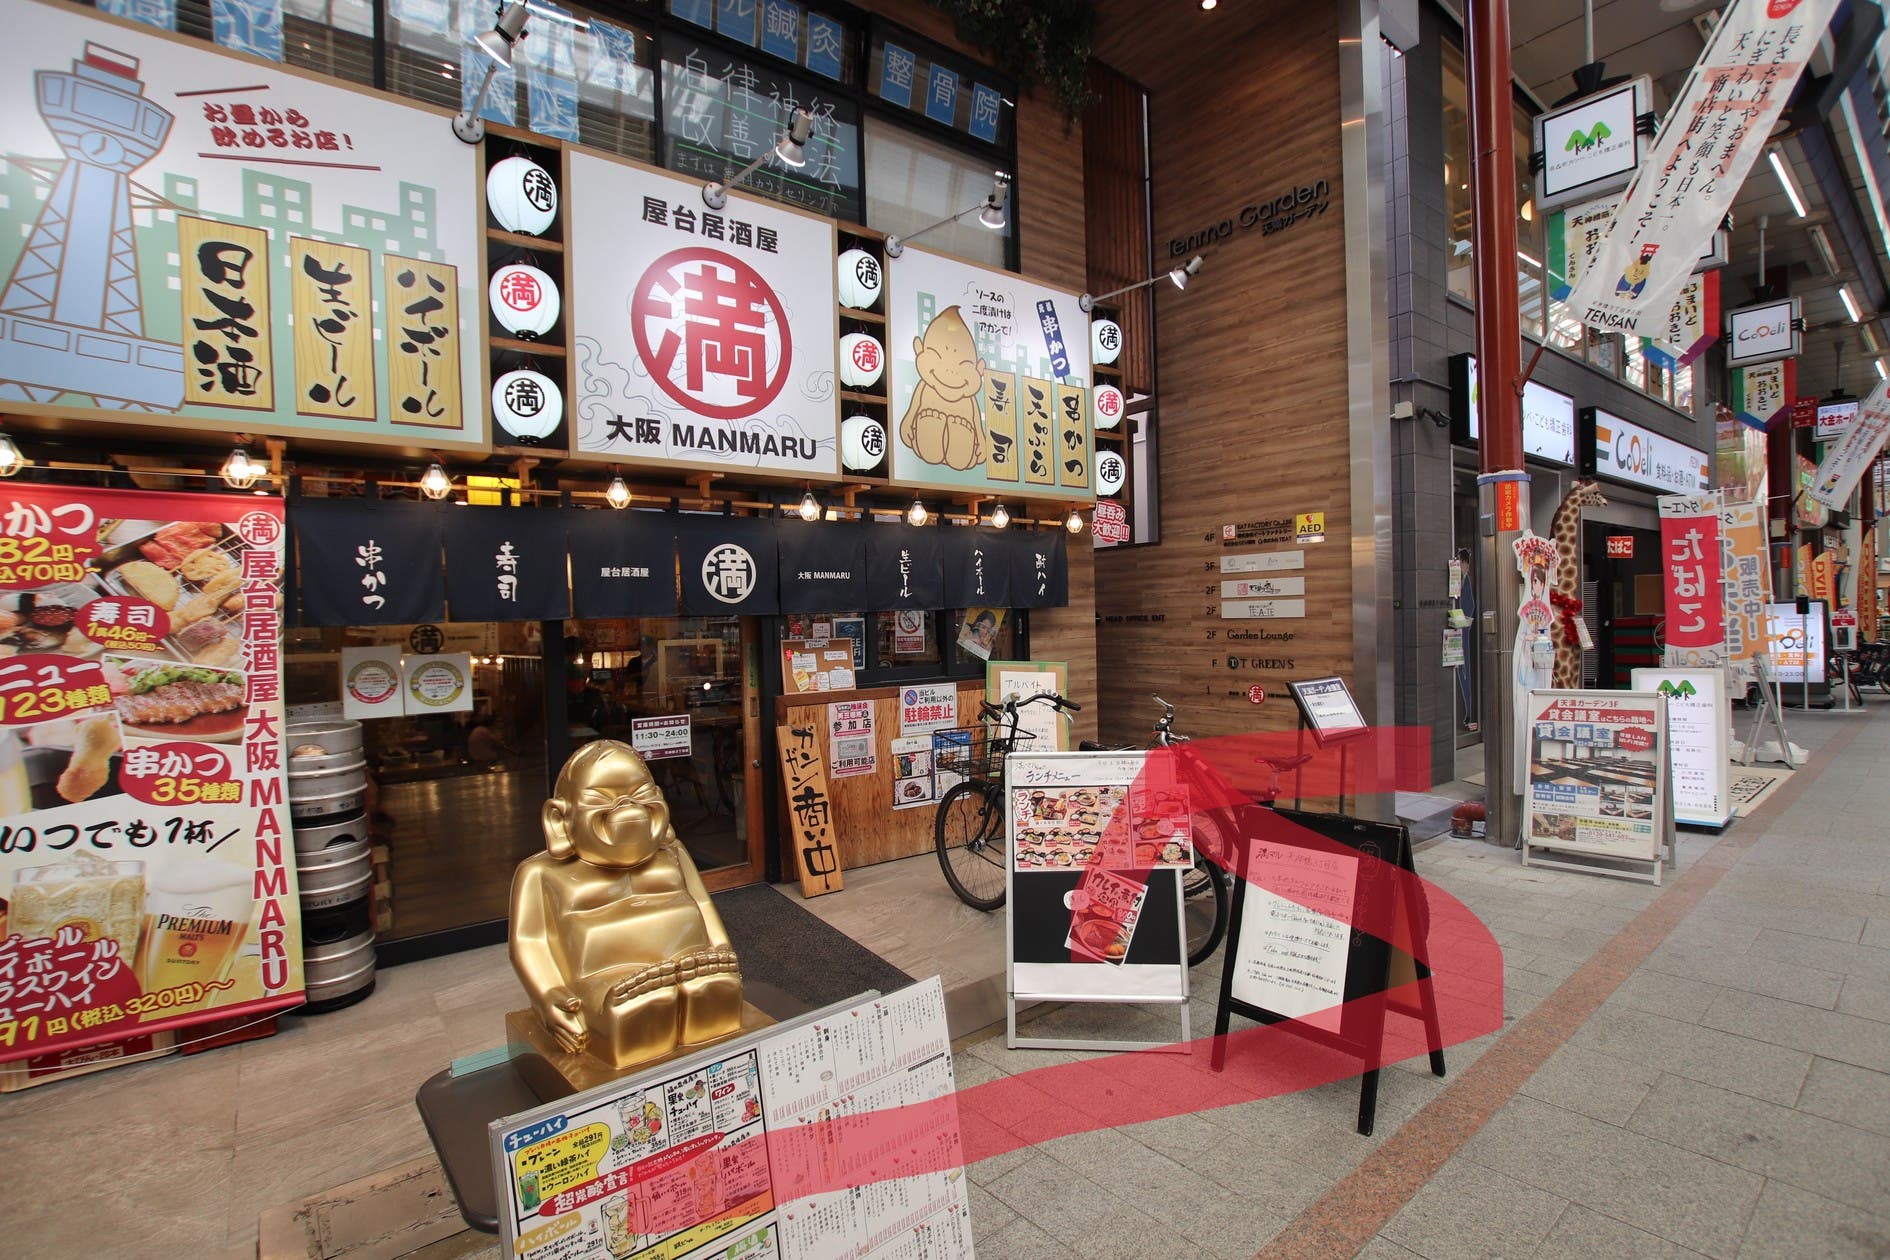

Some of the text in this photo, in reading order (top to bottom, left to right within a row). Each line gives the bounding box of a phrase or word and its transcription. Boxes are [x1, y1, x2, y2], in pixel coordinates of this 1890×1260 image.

[203, 101, 310, 128] お昼から
[525, 169, 556, 212] 満
[1239, 178, 1330, 229] Garden
[641, 195, 779, 254] 屋台居酒屋
[857, 257, 881, 288] 満
[501, 272, 541, 311] 満
[975, 288, 1005, 303] ソースの
[192, 240, 263, 397] 日本酒
[303, 253, 359, 408] 生ビール
[646, 262, 768, 399] 満
[1583, 307, 1638, 331] TENSAN
[396, 268, 450, 418] ハイボール
[1042, 314, 1068, 371] 串かつ
[1100, 325, 1121, 350] 満
[853, 341, 880, 371] 満
[505, 378, 544, 417] 満
[1098, 390, 1120, 415] 満
[987, 377, 1014, 464] 寿司
[1027, 384, 1049, 477] 天ぷら
[1062, 394, 1084, 477] 串かつ
[606, 413, 817, 461] 大阪 MANMARU
[862, 426, 885, 455] 満
[1100, 457, 1121, 483] 満
[242, 513, 278, 544] 満
[1299, 523, 1321, 535] AED
[1607, 541, 1632, 553] たばこ
[355, 539, 386, 610] 串かつ
[495, 541, 520, 602] 寿司
[600, 566, 649, 578] 屋台居酒屋
[704, 548, 753, 597] 満
[797, 571, 851, 580] 大阪 MANMARU
[1204, 562, 1216, 571] 3F
[1205, 586, 1216, 595] 2F
[89, 601, 156, 627] 寿司
[1206, 606, 1217, 616] 2F
[240, 549, 280, 705] 屋台居酒屋
[1206, 630, 1217, 640] 2F
[904, 704, 955, 723] 駐輪禁止
[244, 709, 281, 773] 大阪
[125, 748, 226, 779] 串かつ
[831, 756, 876, 771] ご利用可能店
[1025, 769, 1081, 785] ランチメニュー
[150, 777, 242, 803] 35種類
[1016, 791, 1033, 820] ランチ
[249, 776, 290, 990] MANMARU
[157, 913, 234, 936] PREMIUM
[714, 1084, 735, 1099] ワイン
[509, 1118, 564, 1149] チューハイ
